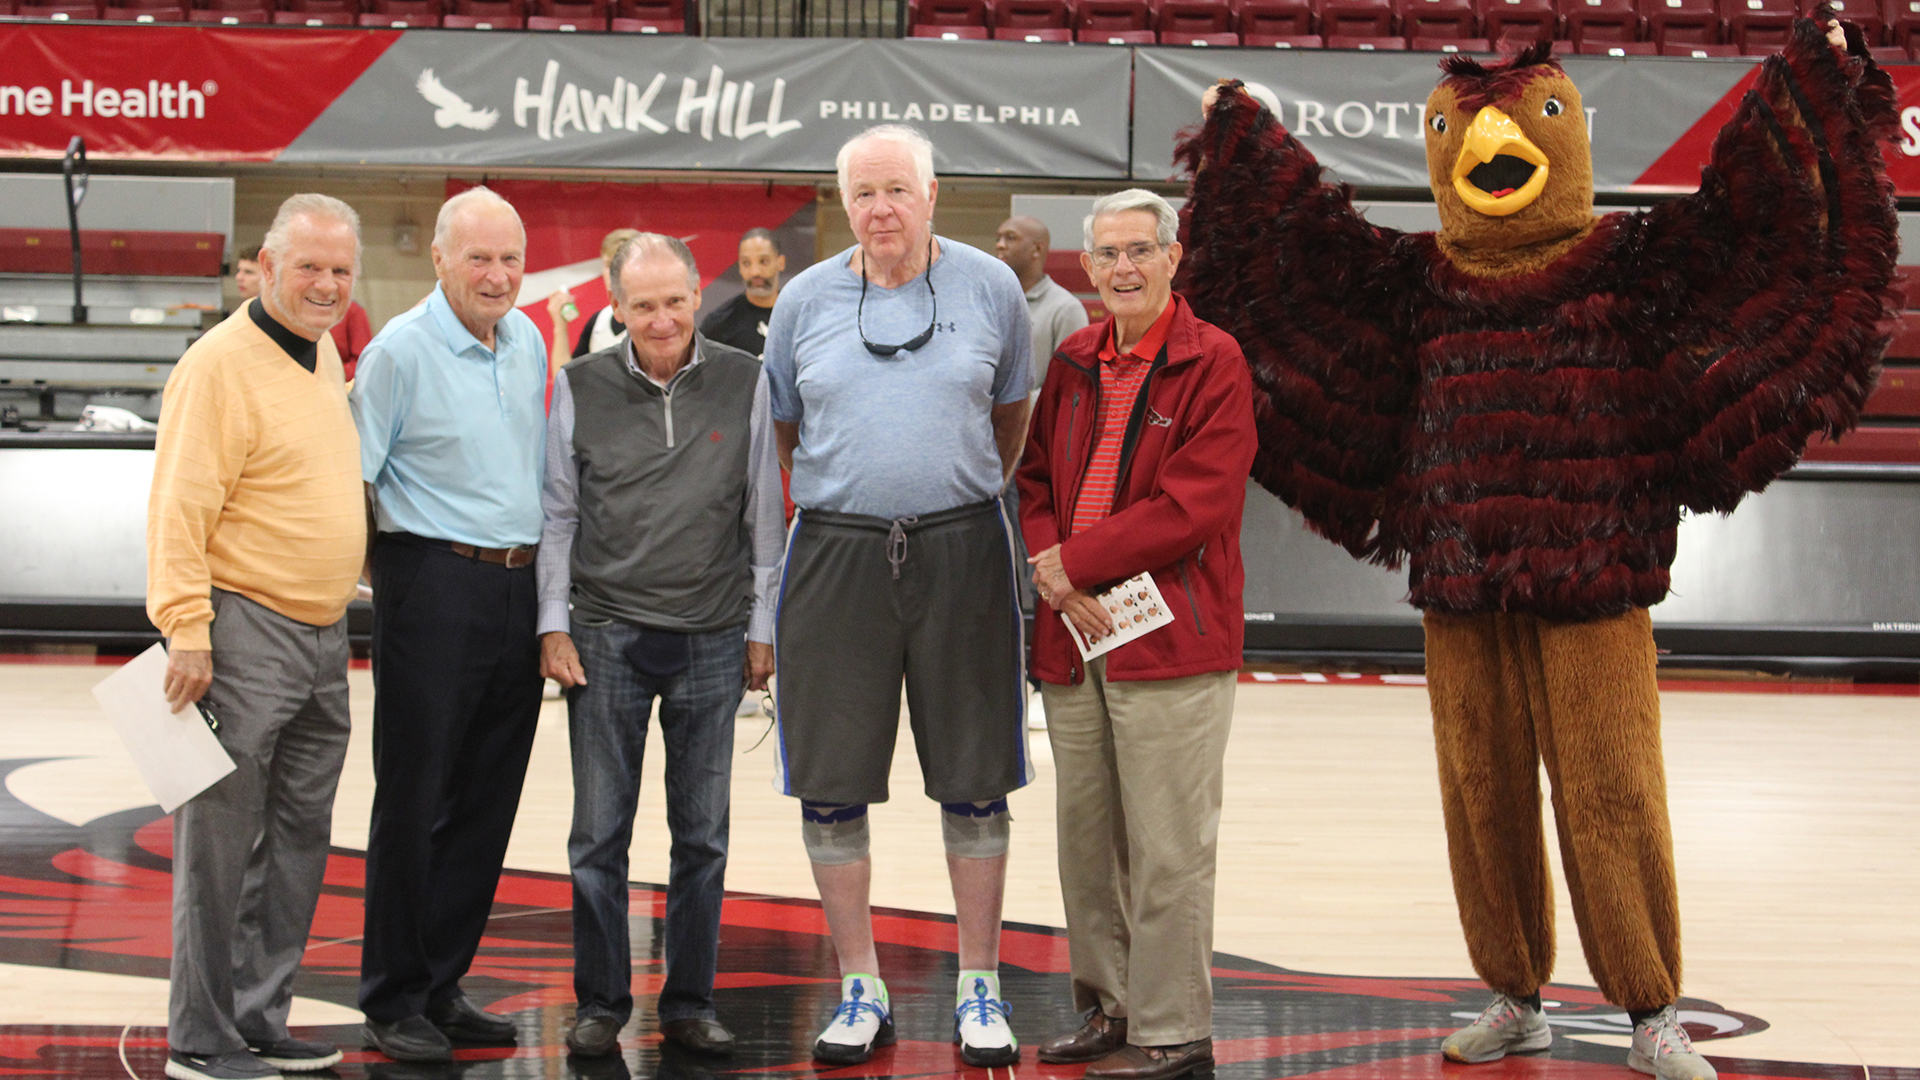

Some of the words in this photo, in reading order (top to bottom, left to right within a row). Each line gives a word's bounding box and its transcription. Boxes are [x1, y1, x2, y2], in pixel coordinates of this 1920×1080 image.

[513, 59, 670, 141] HAWK
[675, 64, 802, 141] HILL
[819, 100, 1081, 126] PHILADELPHIA
